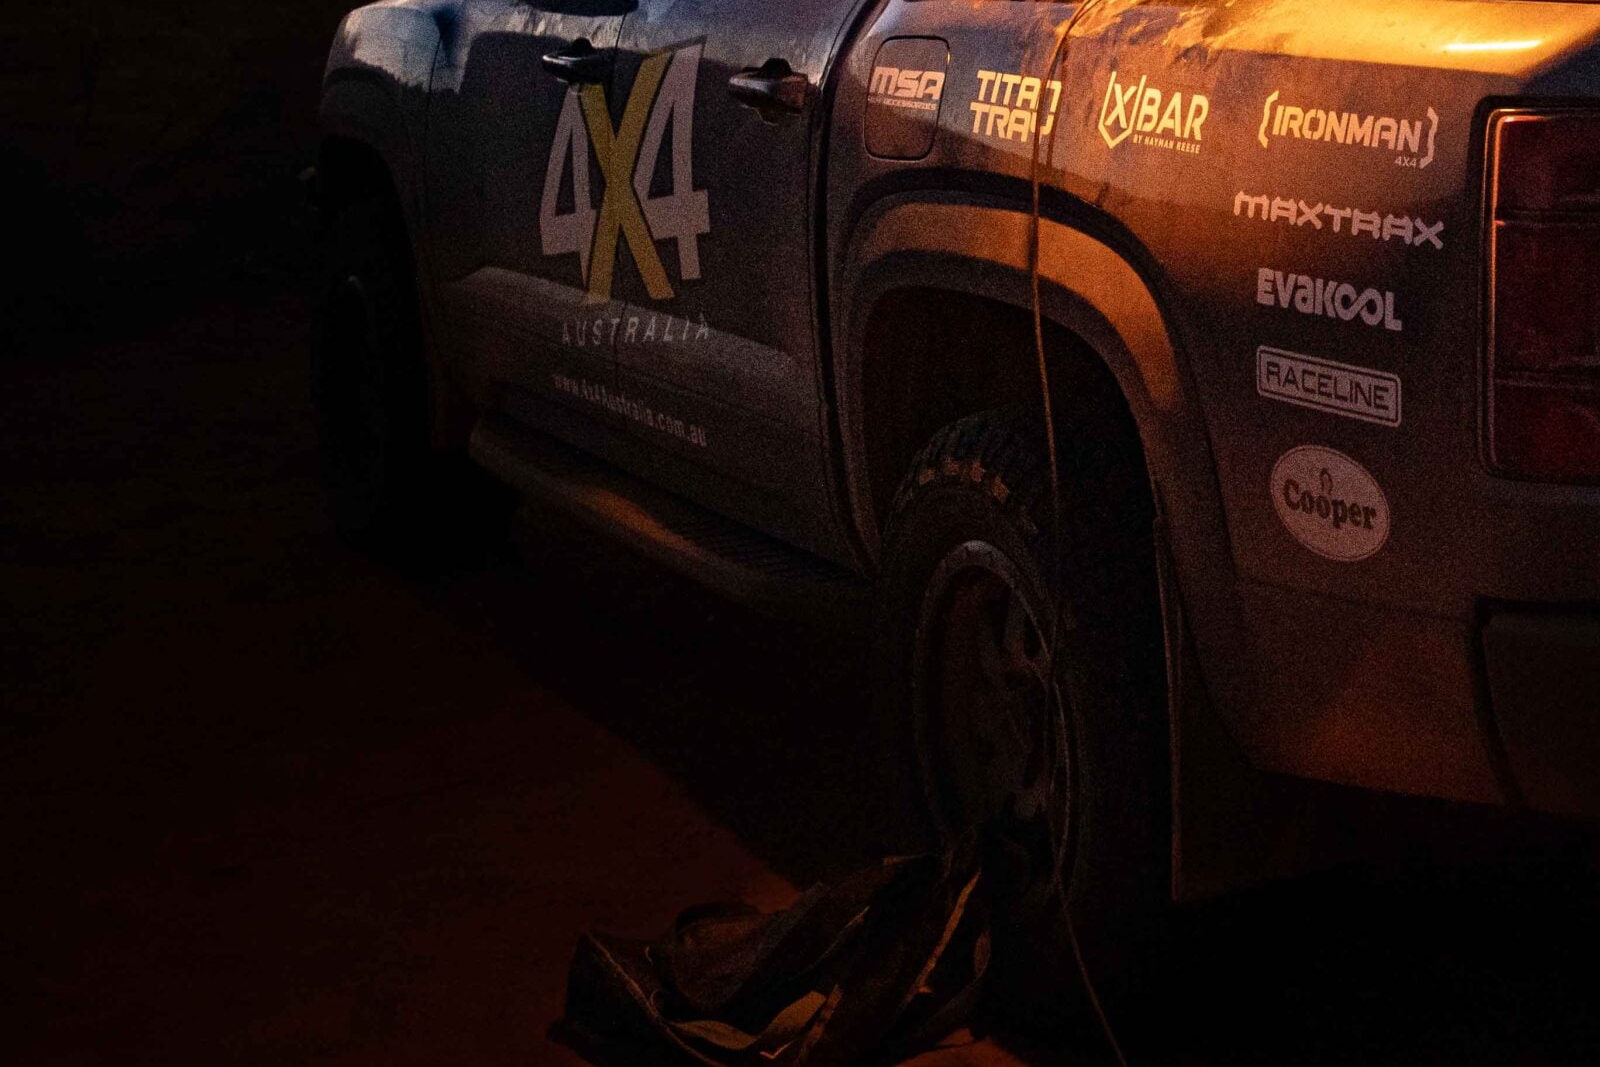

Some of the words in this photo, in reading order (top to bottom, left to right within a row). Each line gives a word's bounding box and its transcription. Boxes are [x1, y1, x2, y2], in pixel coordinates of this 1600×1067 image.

[868, 65, 946, 101] MSA
[1132, 133, 1143, 144] BY
[1144, 135, 1175, 150] HAYMAN
[1176, 140, 1201, 155] REESE
[1271, 104, 1423, 154] IRONMAN
[1393, 155, 1418, 169] 4X4
[1232, 189, 1446, 251] MAXTRAX
[561, 311, 709, 347] AUSTRALIA
[1265, 360, 1391, 412] RACELINE
[1281, 477, 1378, 530] Cooper
